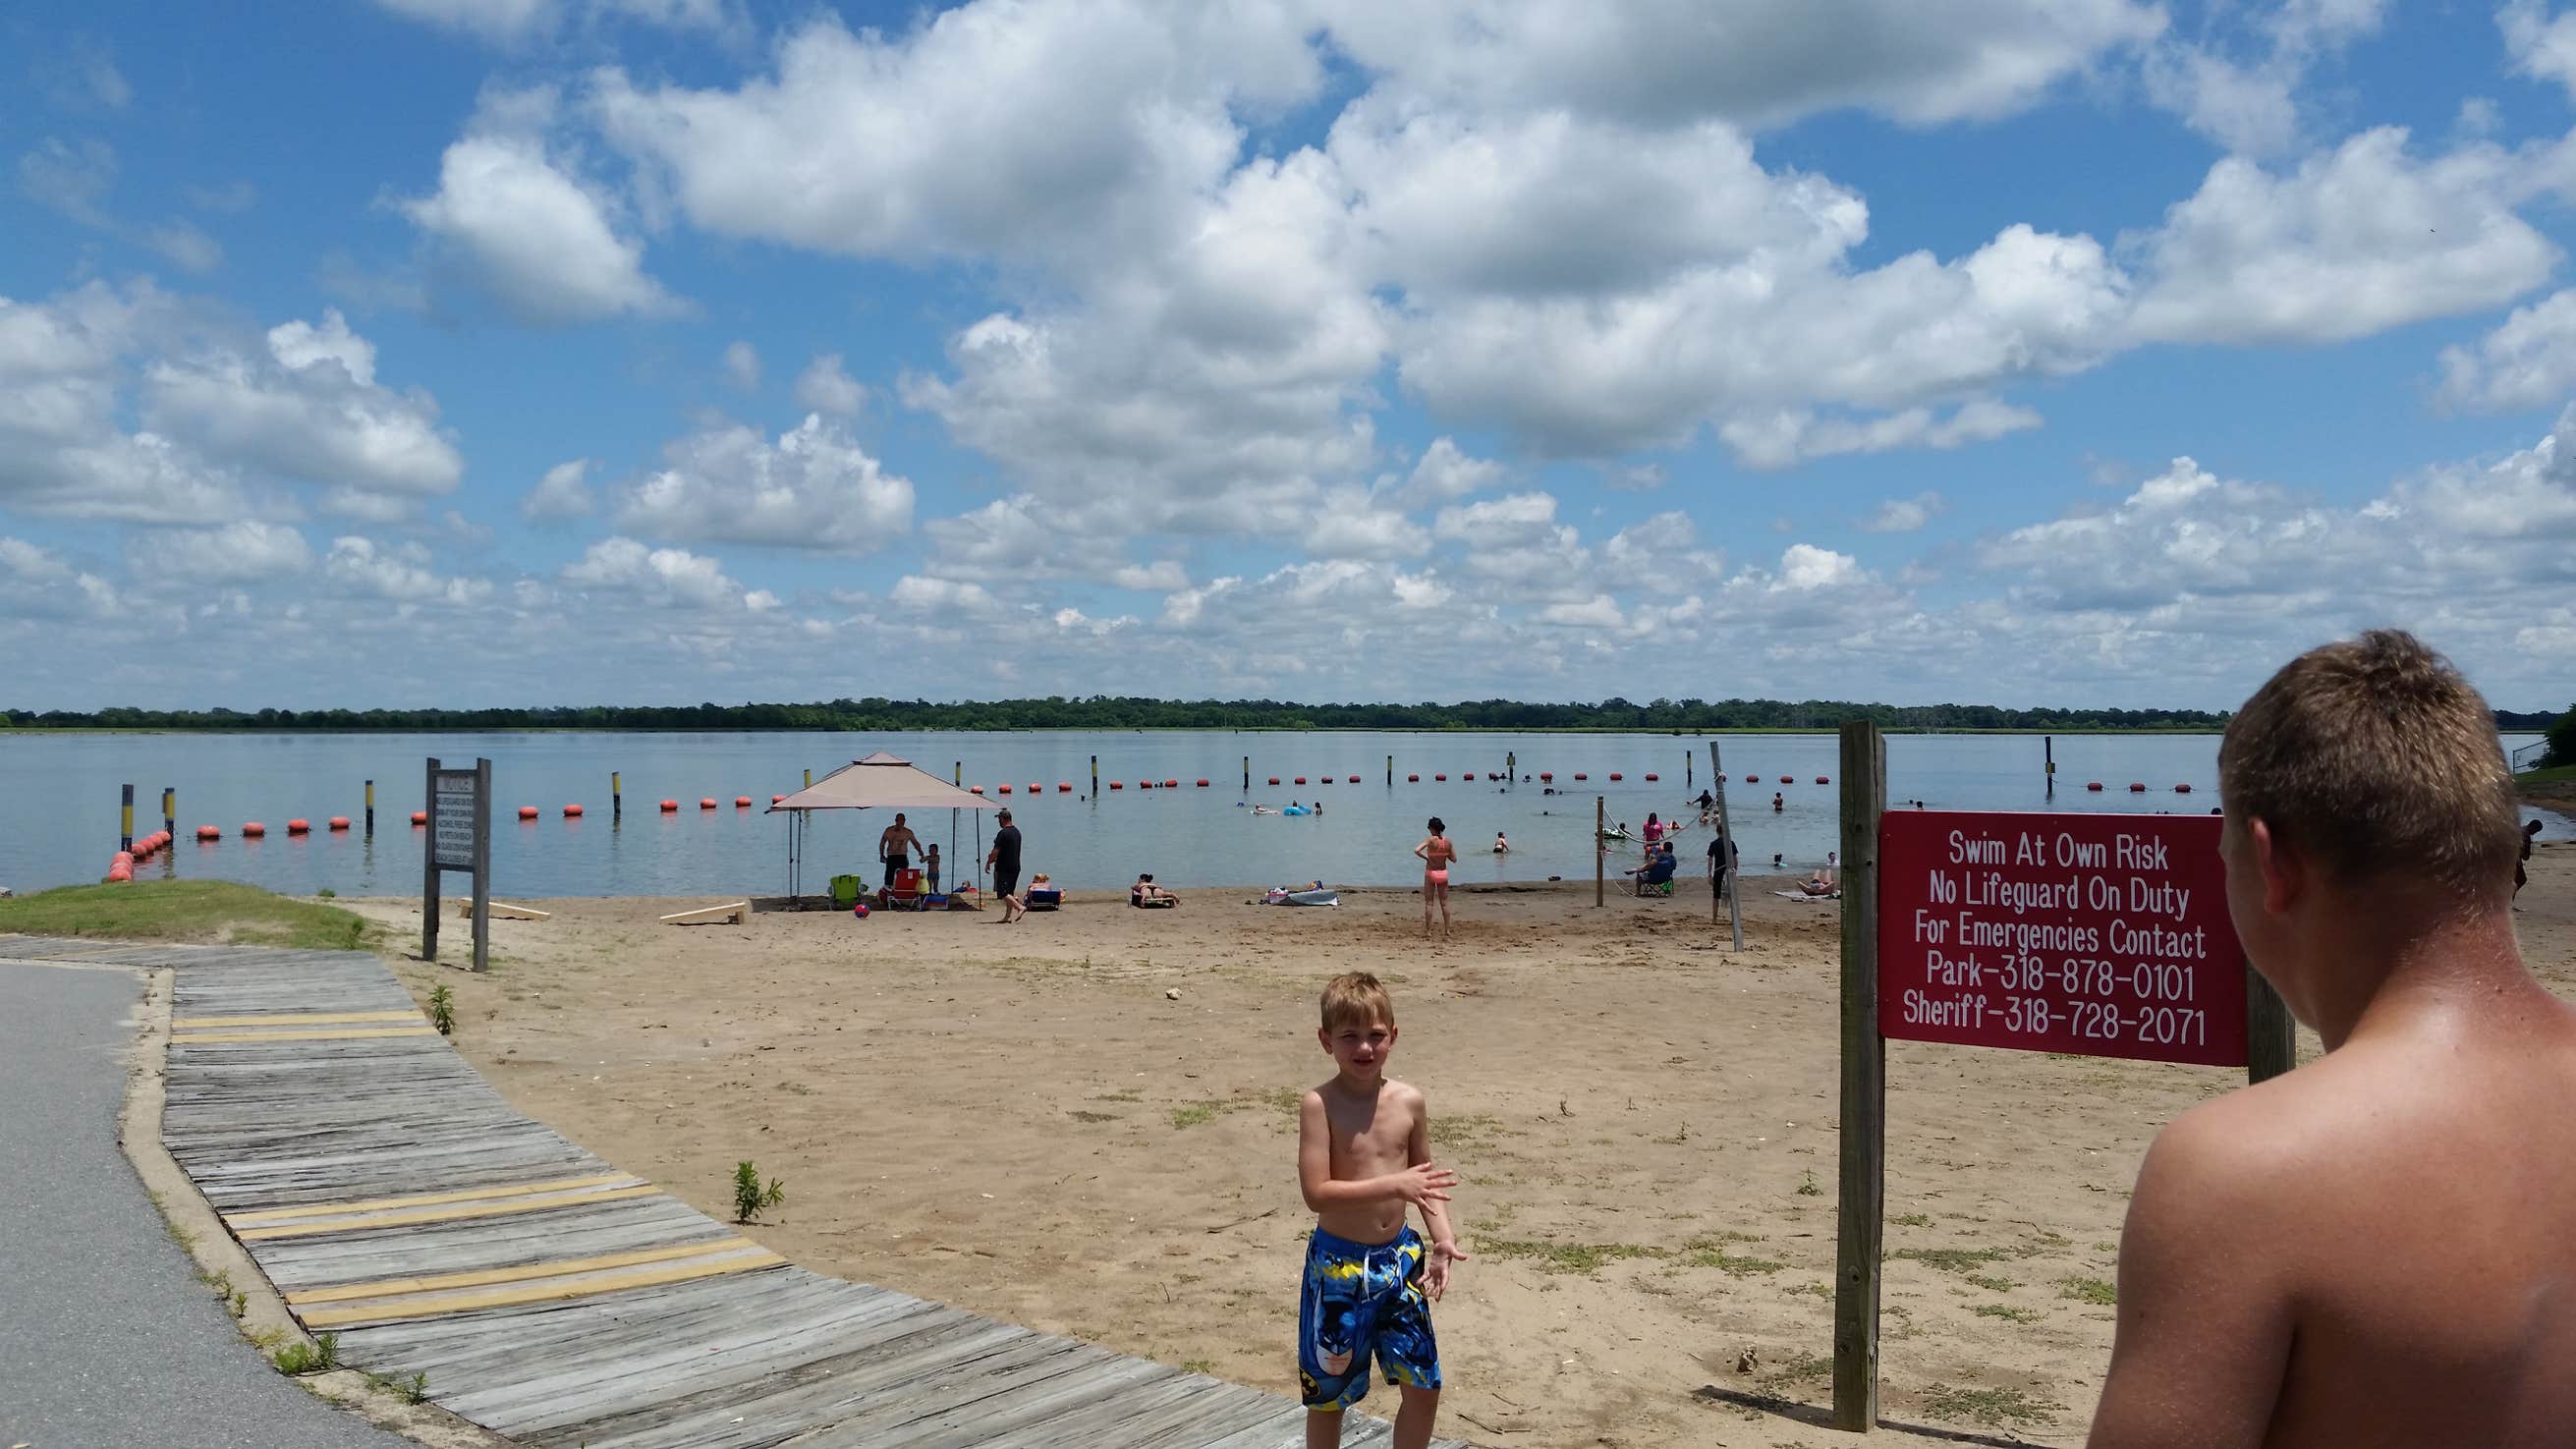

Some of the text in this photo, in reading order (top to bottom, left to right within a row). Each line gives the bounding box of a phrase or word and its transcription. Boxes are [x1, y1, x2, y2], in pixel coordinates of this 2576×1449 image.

[1949, 829, 2168, 870] Swim At Own Risk
[1930, 869, 2190, 921] No Lifeguard On Duty
[1915, 909, 2207, 959] For Emergencies Contact
[1927, 949, 2193, 1002] Park-318-878-0101
[1903, 988, 2205, 1046] Sheriff-318-728-2071
